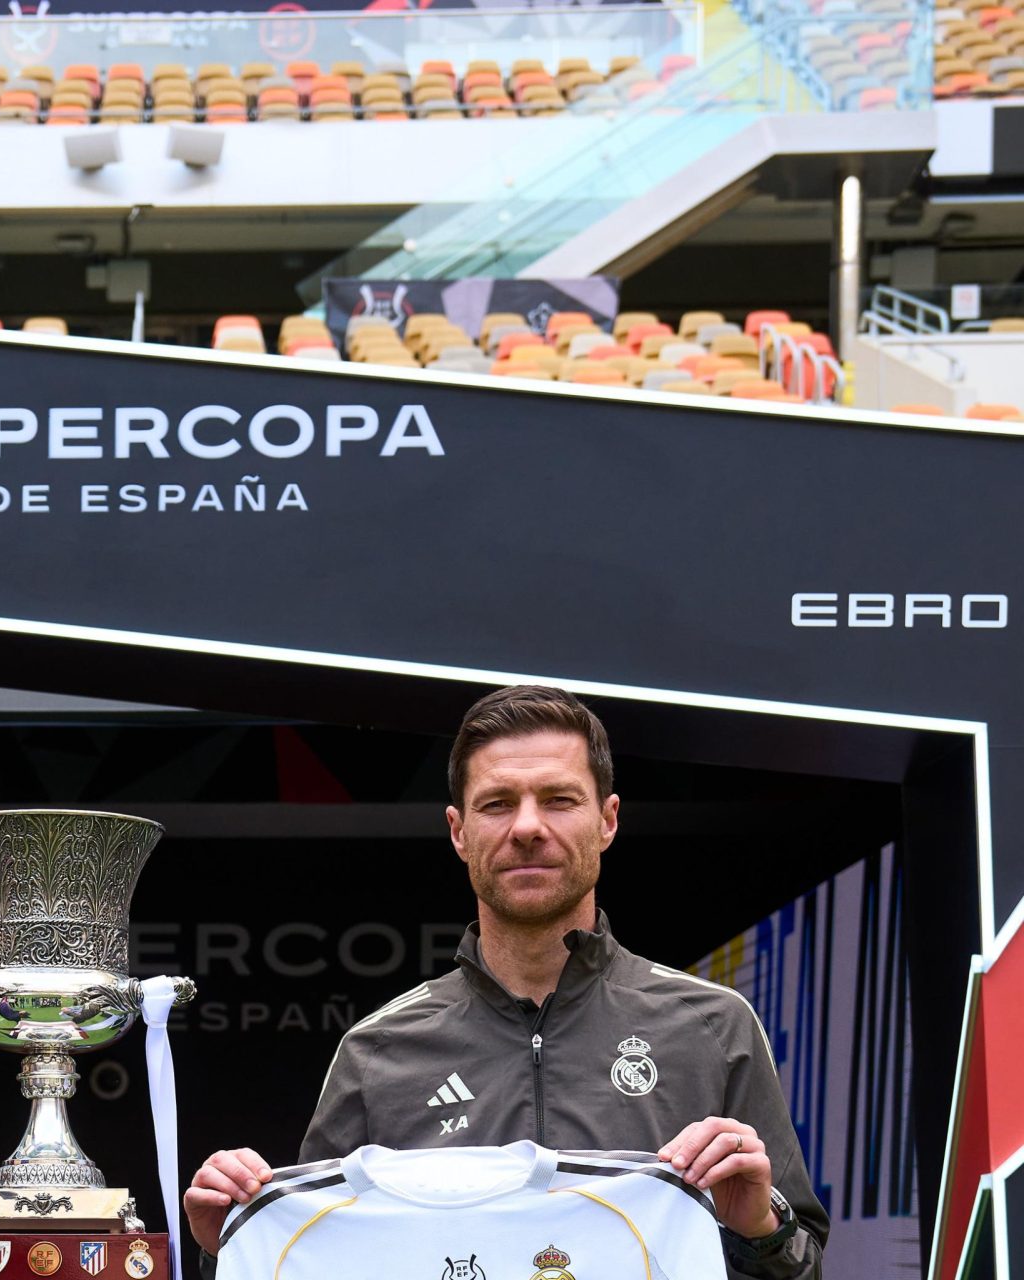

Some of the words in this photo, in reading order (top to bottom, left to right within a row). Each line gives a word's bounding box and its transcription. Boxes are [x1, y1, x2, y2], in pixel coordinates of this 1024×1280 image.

[81, 475, 309, 513] ESPAÑA
[791, 592, 1008, 628] EBRO
[439, 1114, 469, 1137] XA
